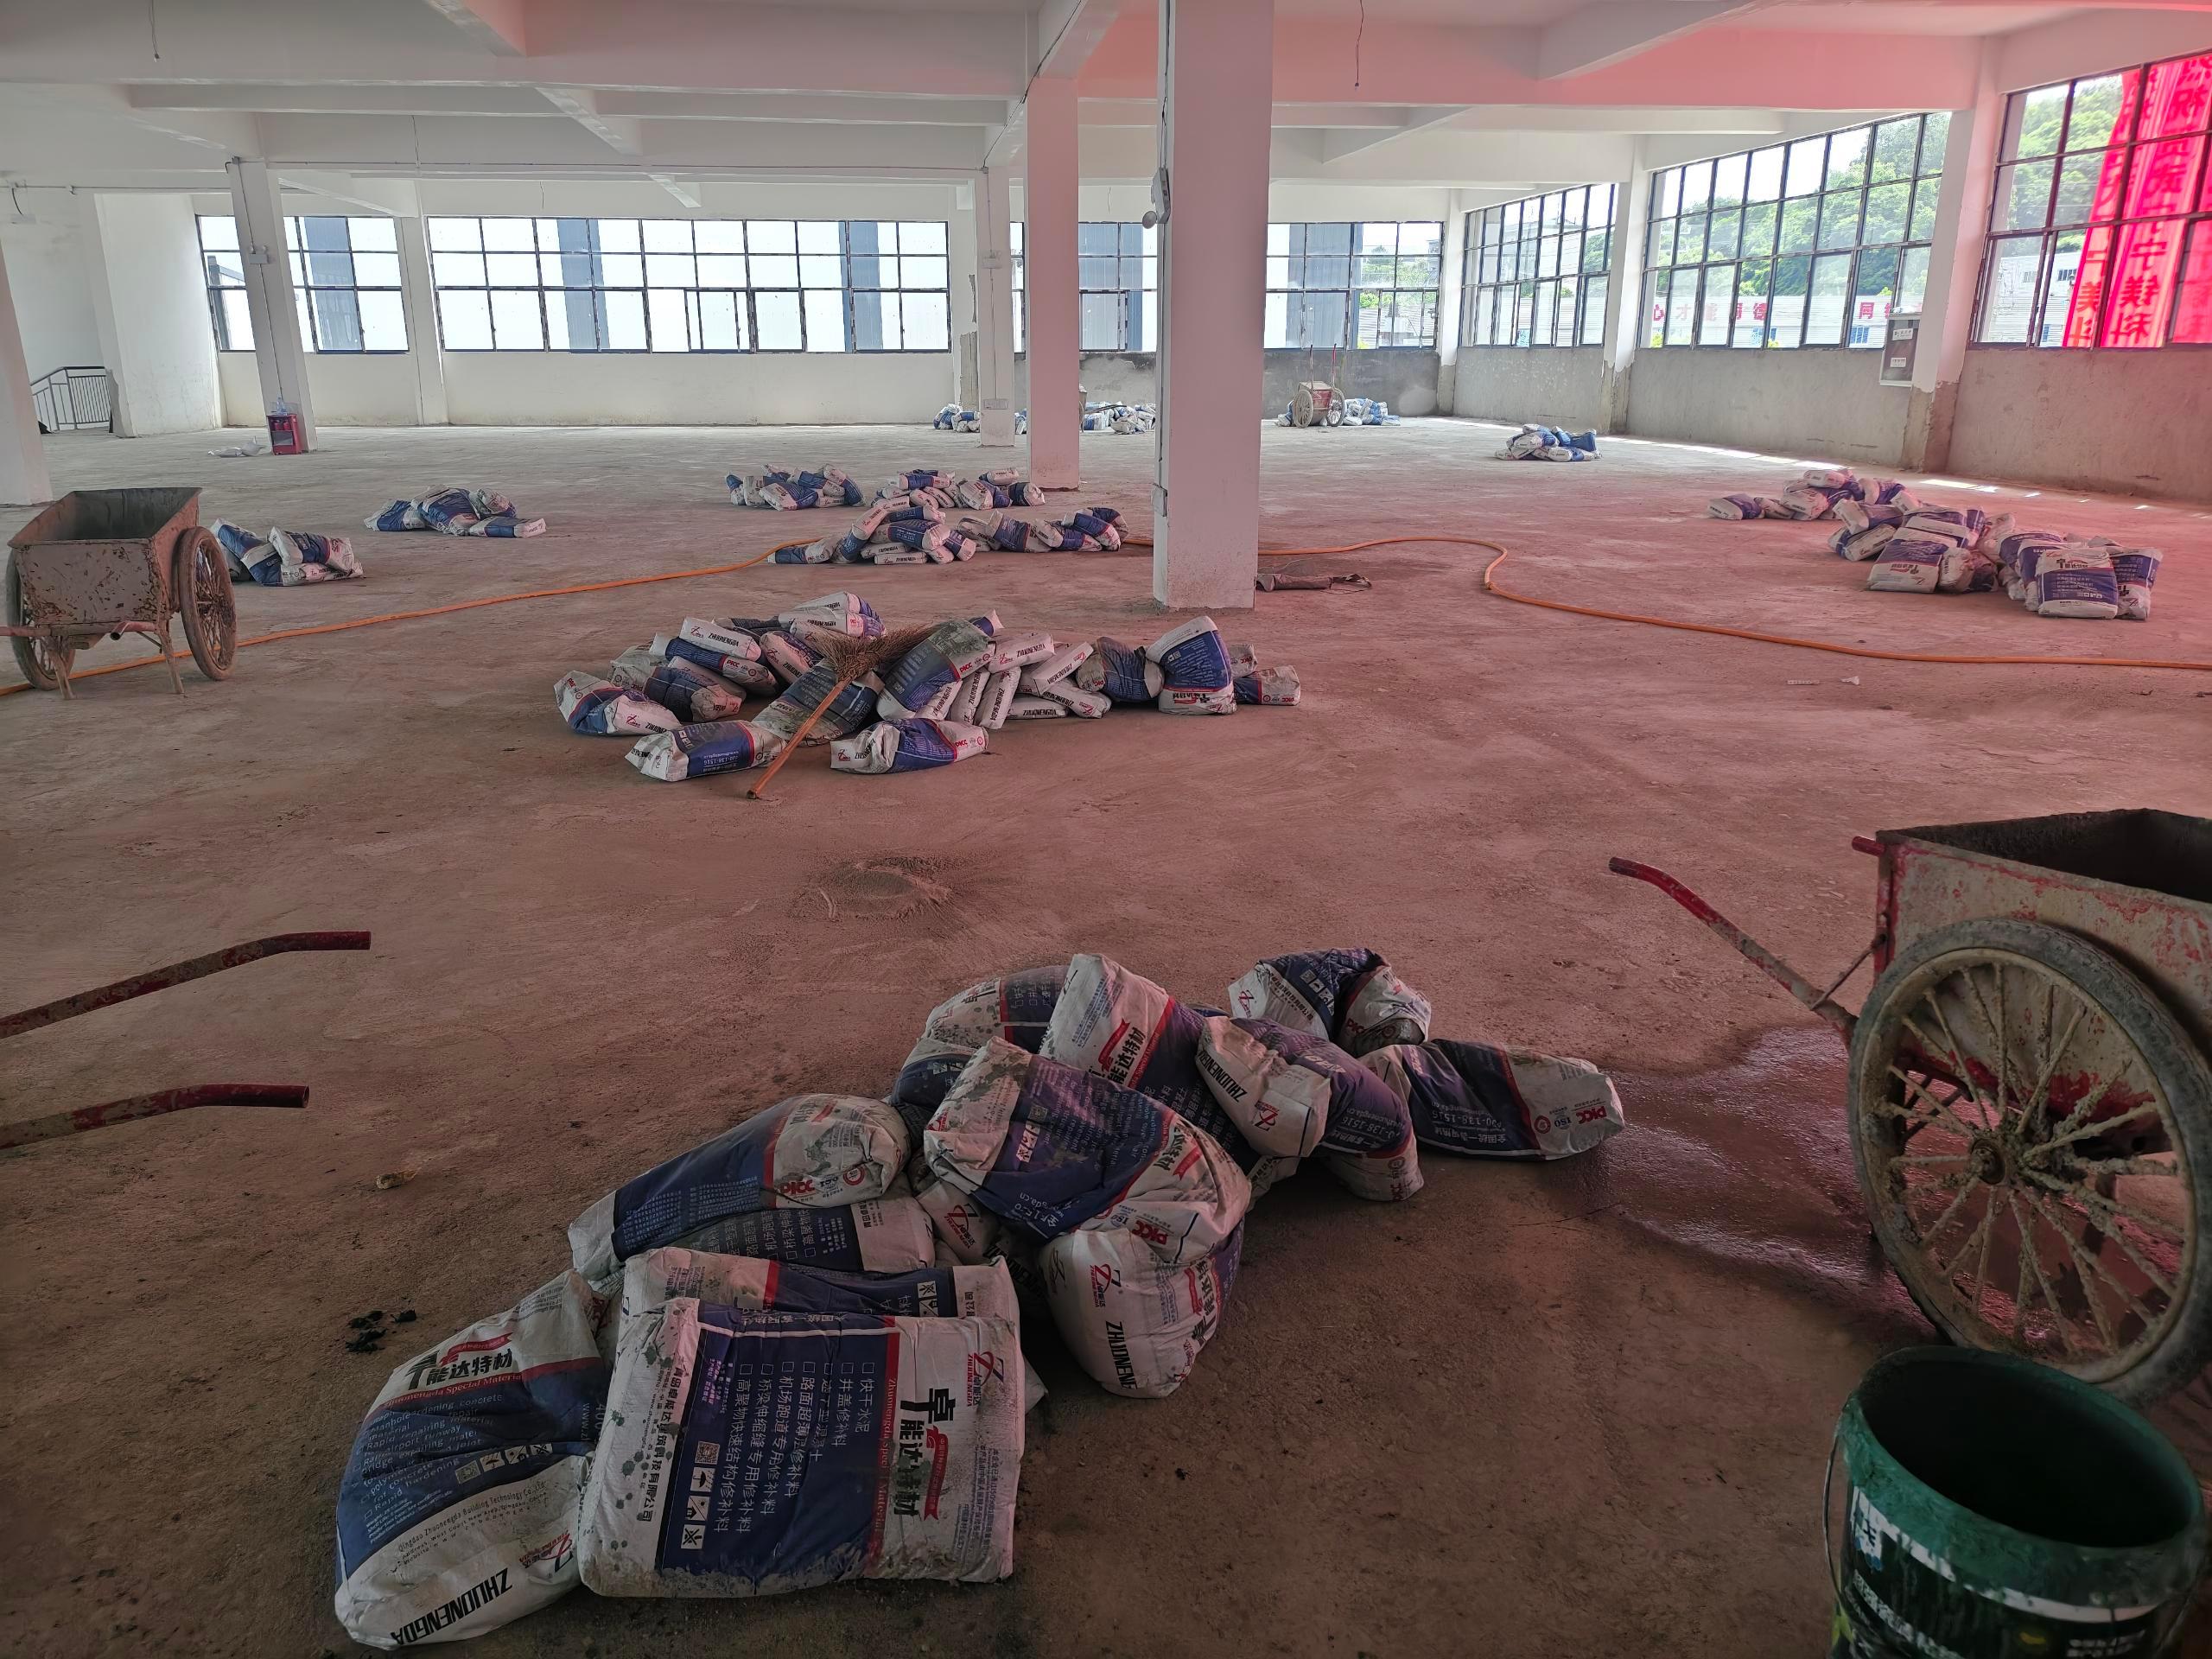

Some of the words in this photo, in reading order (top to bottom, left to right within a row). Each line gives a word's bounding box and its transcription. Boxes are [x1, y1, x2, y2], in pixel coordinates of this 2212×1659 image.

[1575, 1105, 1606, 1124] PICC
[779, 1179, 816, 1196] PICC
[1131, 1219, 1168, 1245] PICC
[446, 1381, 481, 1395] Special
[831, 1379, 854, 1448] 井盖修补料
[855, 1379, 878, 1434] 快干水泥
[714, 1378, 752, 1534] 高聚物快速结构修补料
[736, 1378, 775, 1534] 桥梁伸缩缝专用修补料
[760, 1376, 796, 1516] 机场跑道专用修补料
[877, 1440, 892, 1483] Specil
[893, 1388, 957, 1516] 卓能达特材
[391, 1567, 513, 1645] ZHUONENGDA
